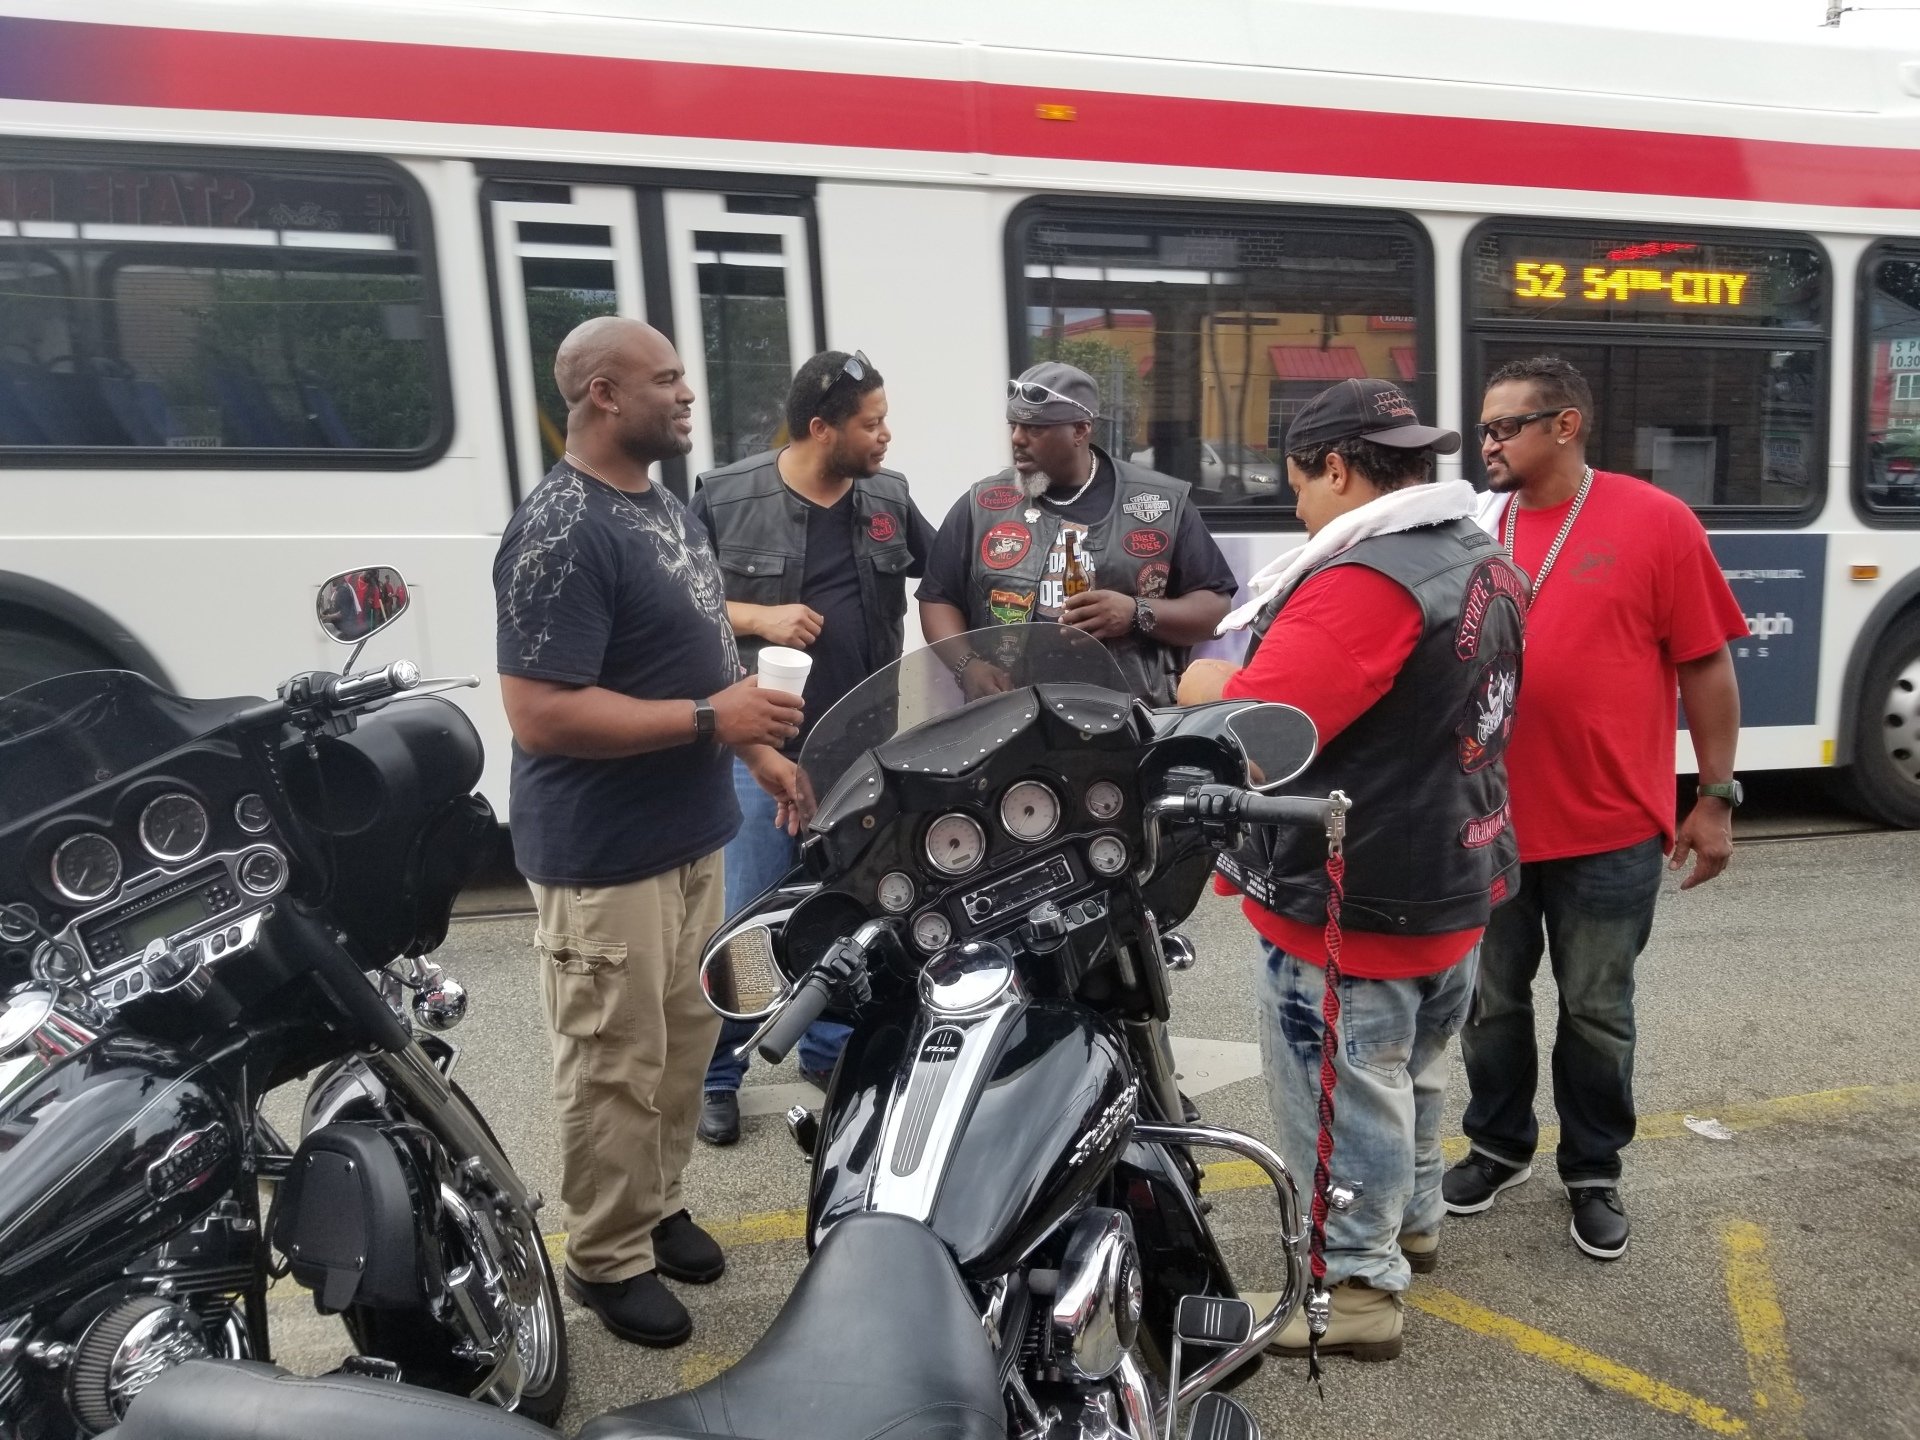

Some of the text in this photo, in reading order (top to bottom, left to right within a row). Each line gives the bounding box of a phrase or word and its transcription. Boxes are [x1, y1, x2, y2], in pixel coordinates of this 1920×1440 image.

[1515, 262, 1566, 298] 52
[1131, 533, 1156, 543] Bigg
[1131, 541, 1161, 551] Dogg
